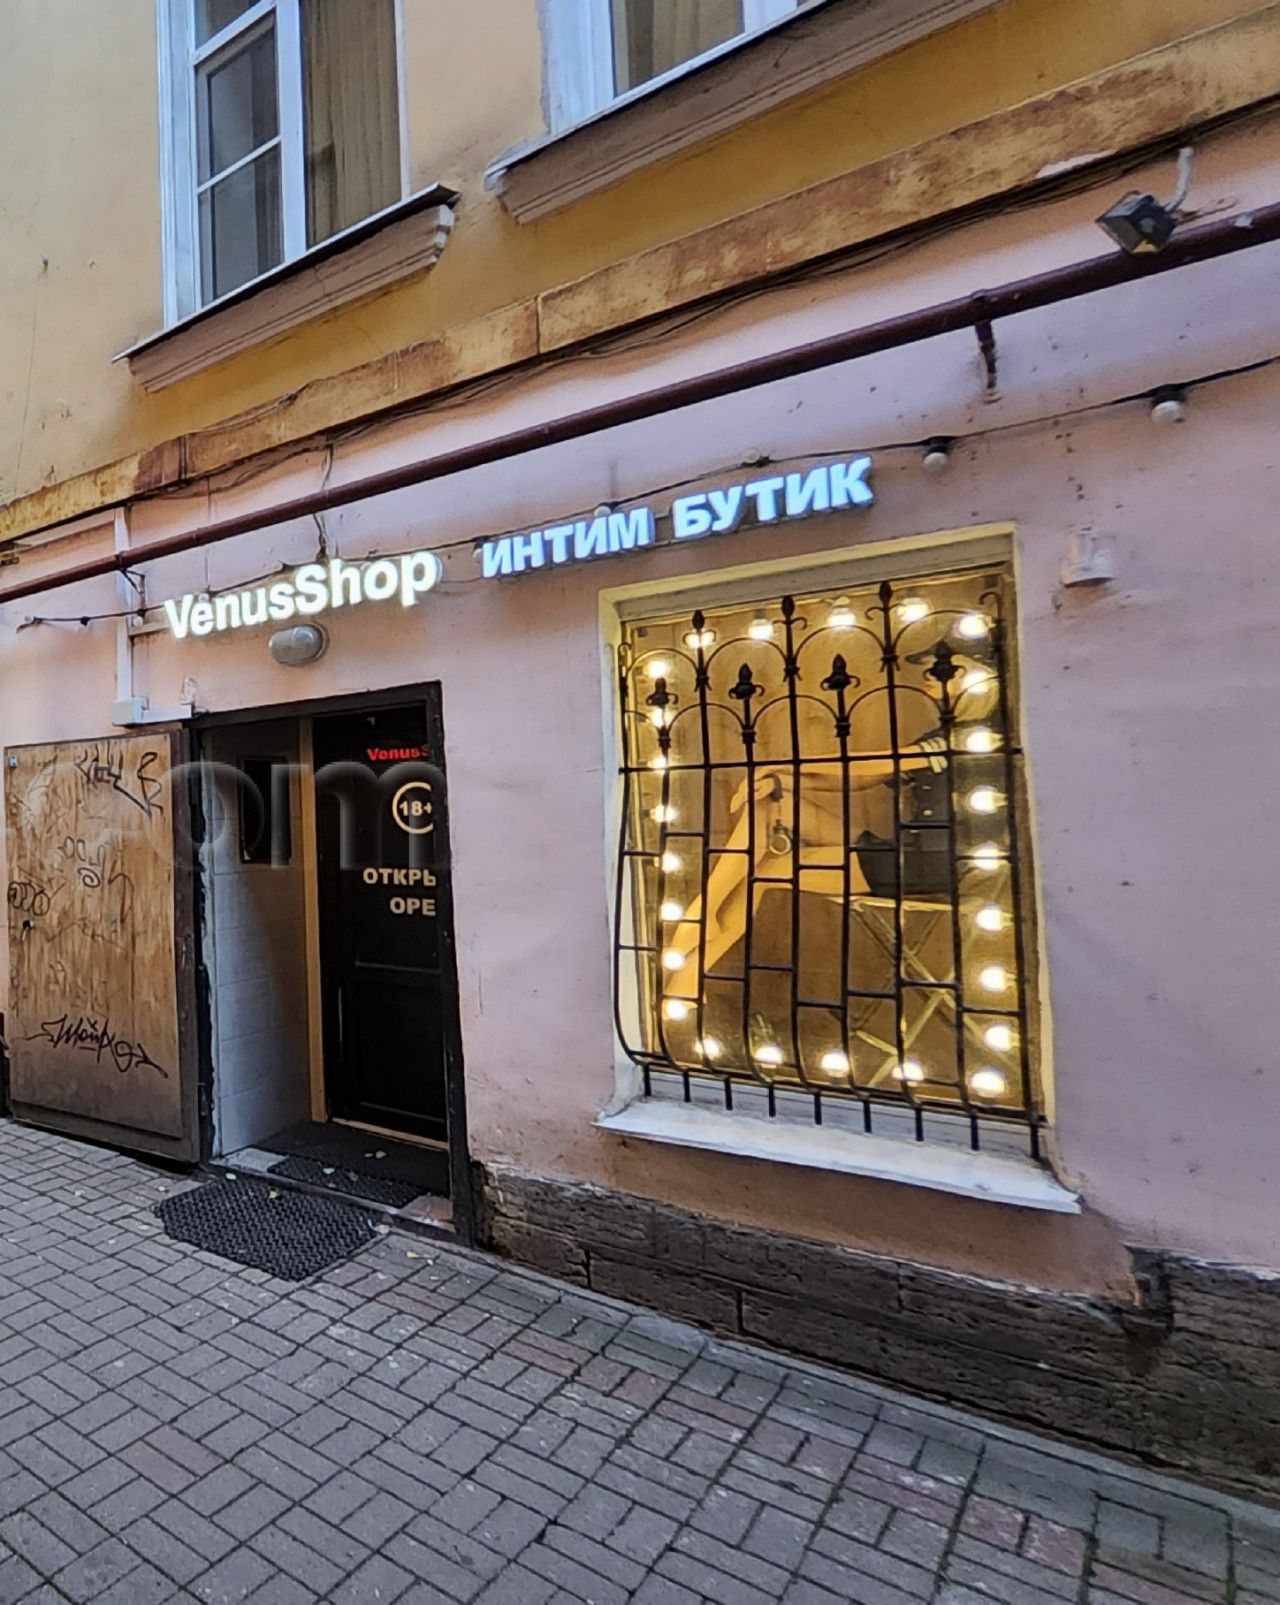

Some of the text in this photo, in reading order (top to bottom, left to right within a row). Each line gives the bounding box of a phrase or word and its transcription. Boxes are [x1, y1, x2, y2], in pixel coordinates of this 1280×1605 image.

[482, 456, 875, 578] ИНТИМ БУТИК
[164, 550, 443, 639] VenusShop
[399, 801, 432, 816] 18+
[390, 897, 436, 916] OPE
